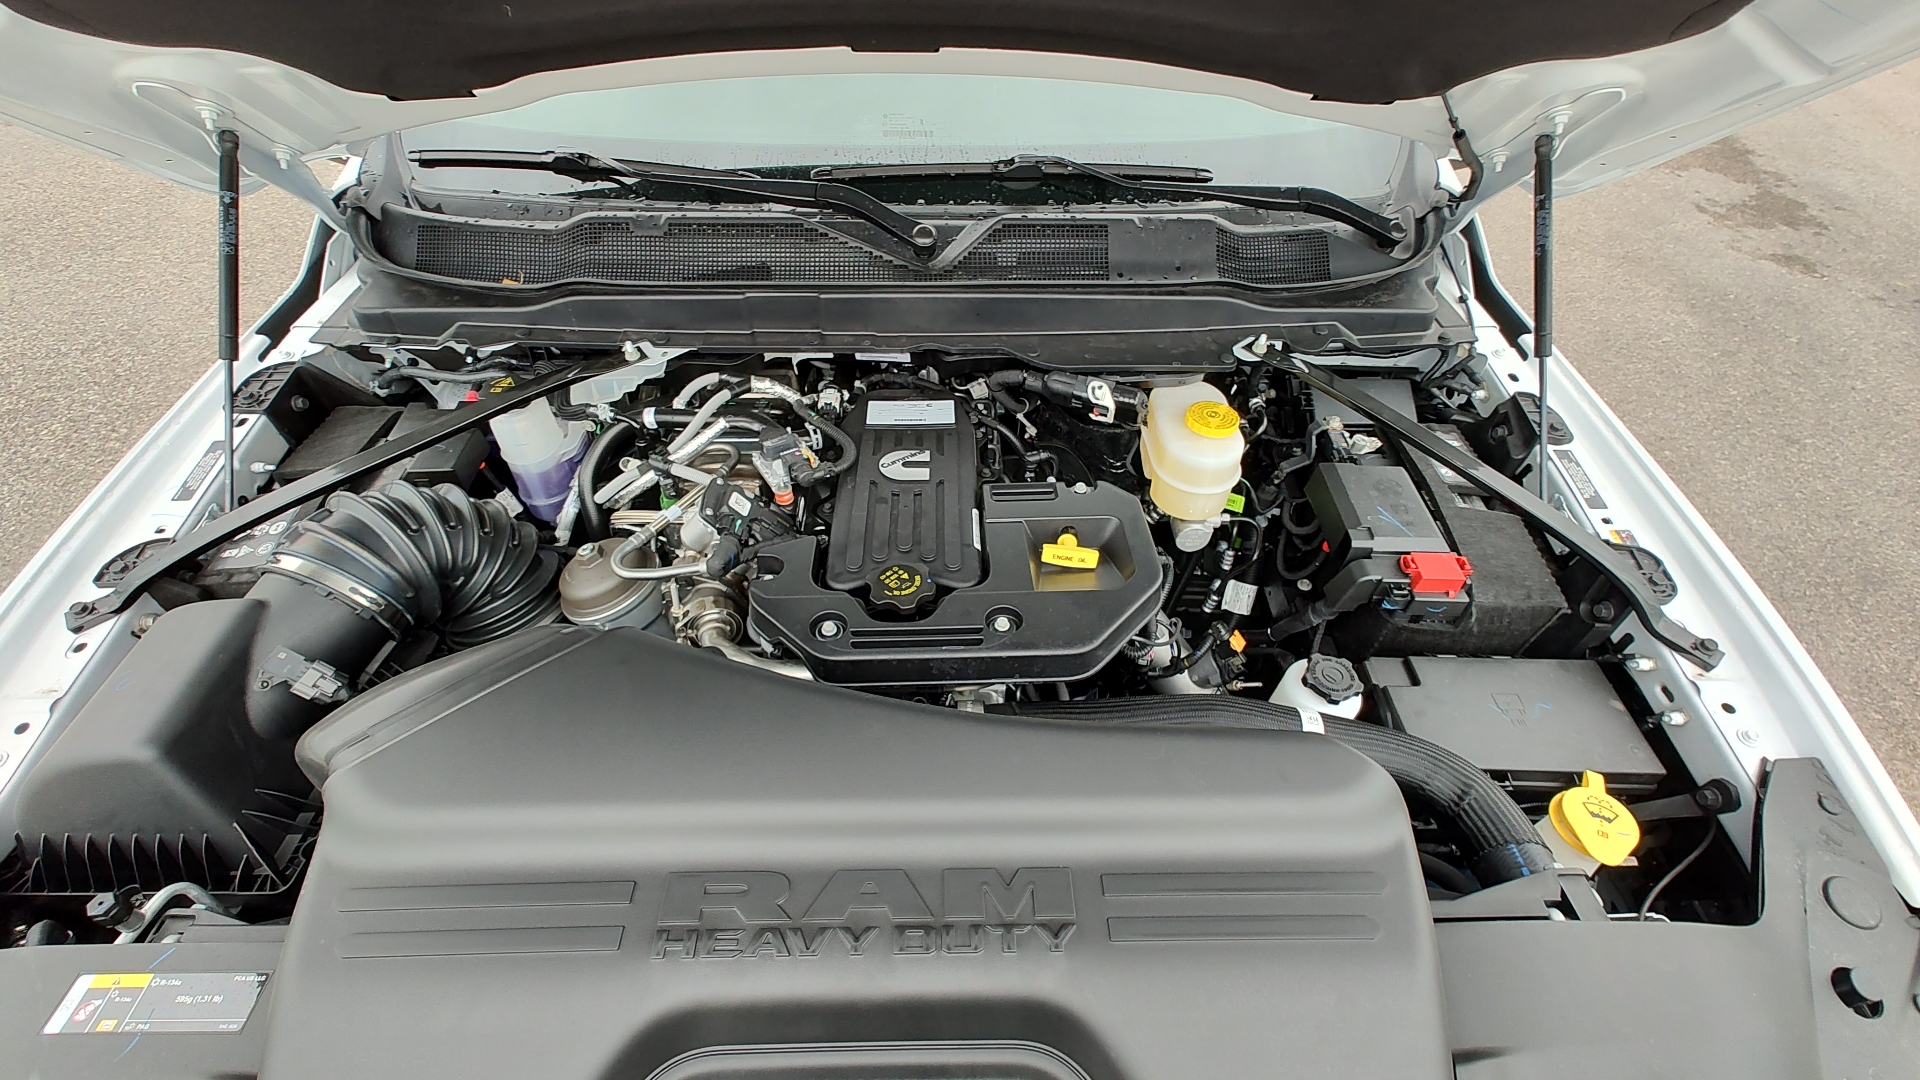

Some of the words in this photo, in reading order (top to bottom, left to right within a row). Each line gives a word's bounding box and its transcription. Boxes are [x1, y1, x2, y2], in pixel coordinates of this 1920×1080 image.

[880, 450, 926, 469] Cummins
[1052, 553, 1075, 562] ENGINE
[656, 867, 1077, 925] RAM
[650, 924, 881, 961] HEAVY
[891, 922, 1078, 957] DUTY
[174, 995, 194, 1004] 595g
[193, 995, 212, 1004] (1.31
[211, 995, 224, 1004] lb)
